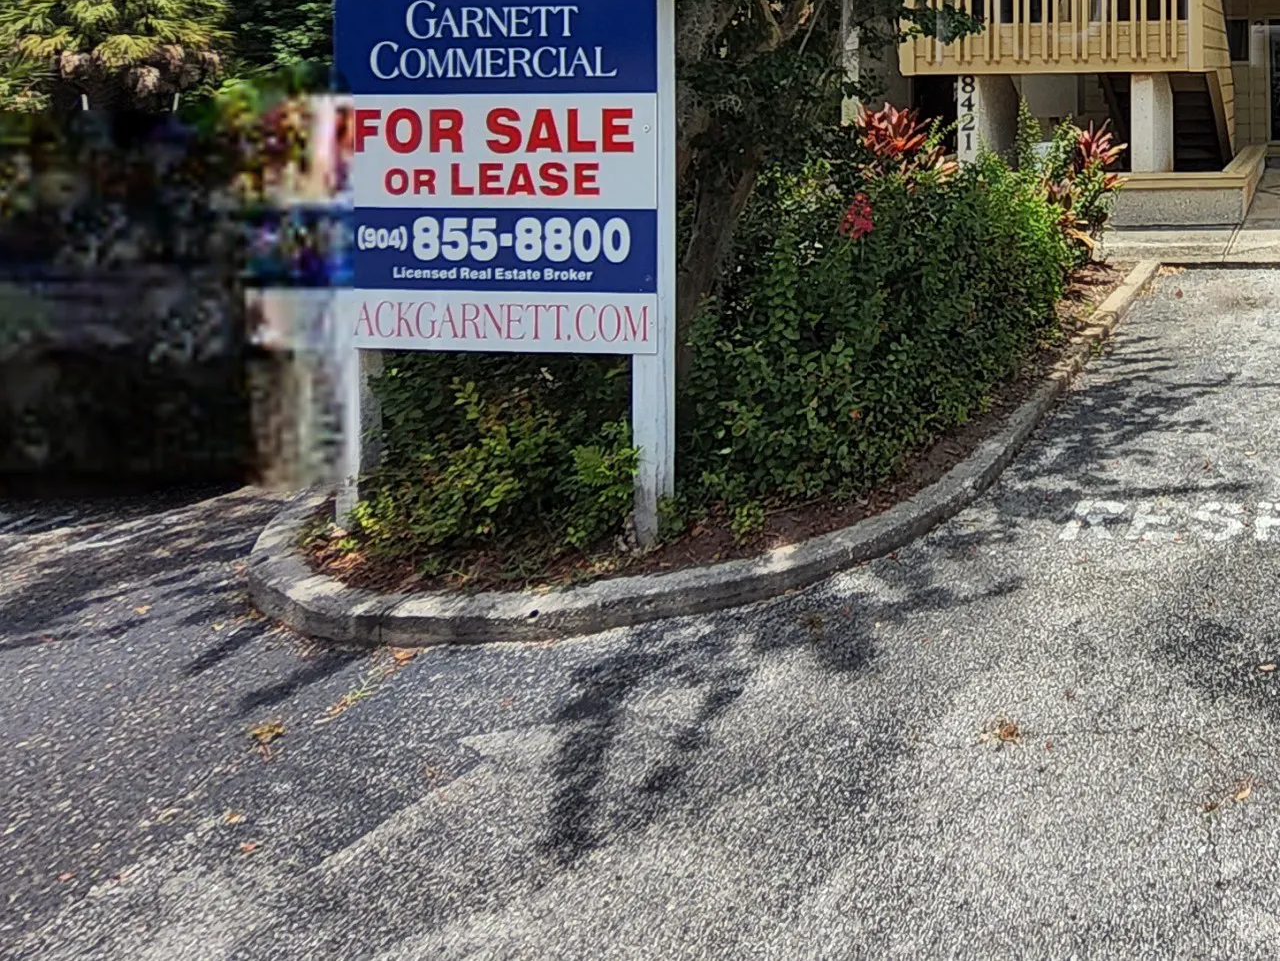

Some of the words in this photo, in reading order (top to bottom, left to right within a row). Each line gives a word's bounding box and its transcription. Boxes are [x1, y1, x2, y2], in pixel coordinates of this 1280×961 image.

[406, 0, 579, 39] GARNETT
[370, 41, 618, 80] COMMERCIAL
[354, 108, 464, 153] FOR
[485, 107, 635, 154] SALE
[960, 75, 976, 151] 8421
[384, 168, 436, 196] OR
[450, 162, 600, 196] LEASE
[357, 225, 408, 251] (904)
[412, 216, 631, 263] 855-8800
[393, 266, 457, 280] Licensed
[460, 267, 492, 280] Real
[495, 268, 541, 281] Estate
[544, 268, 593, 281] Broker
[354, 300, 650, 342] ACKGARNETT.COM
